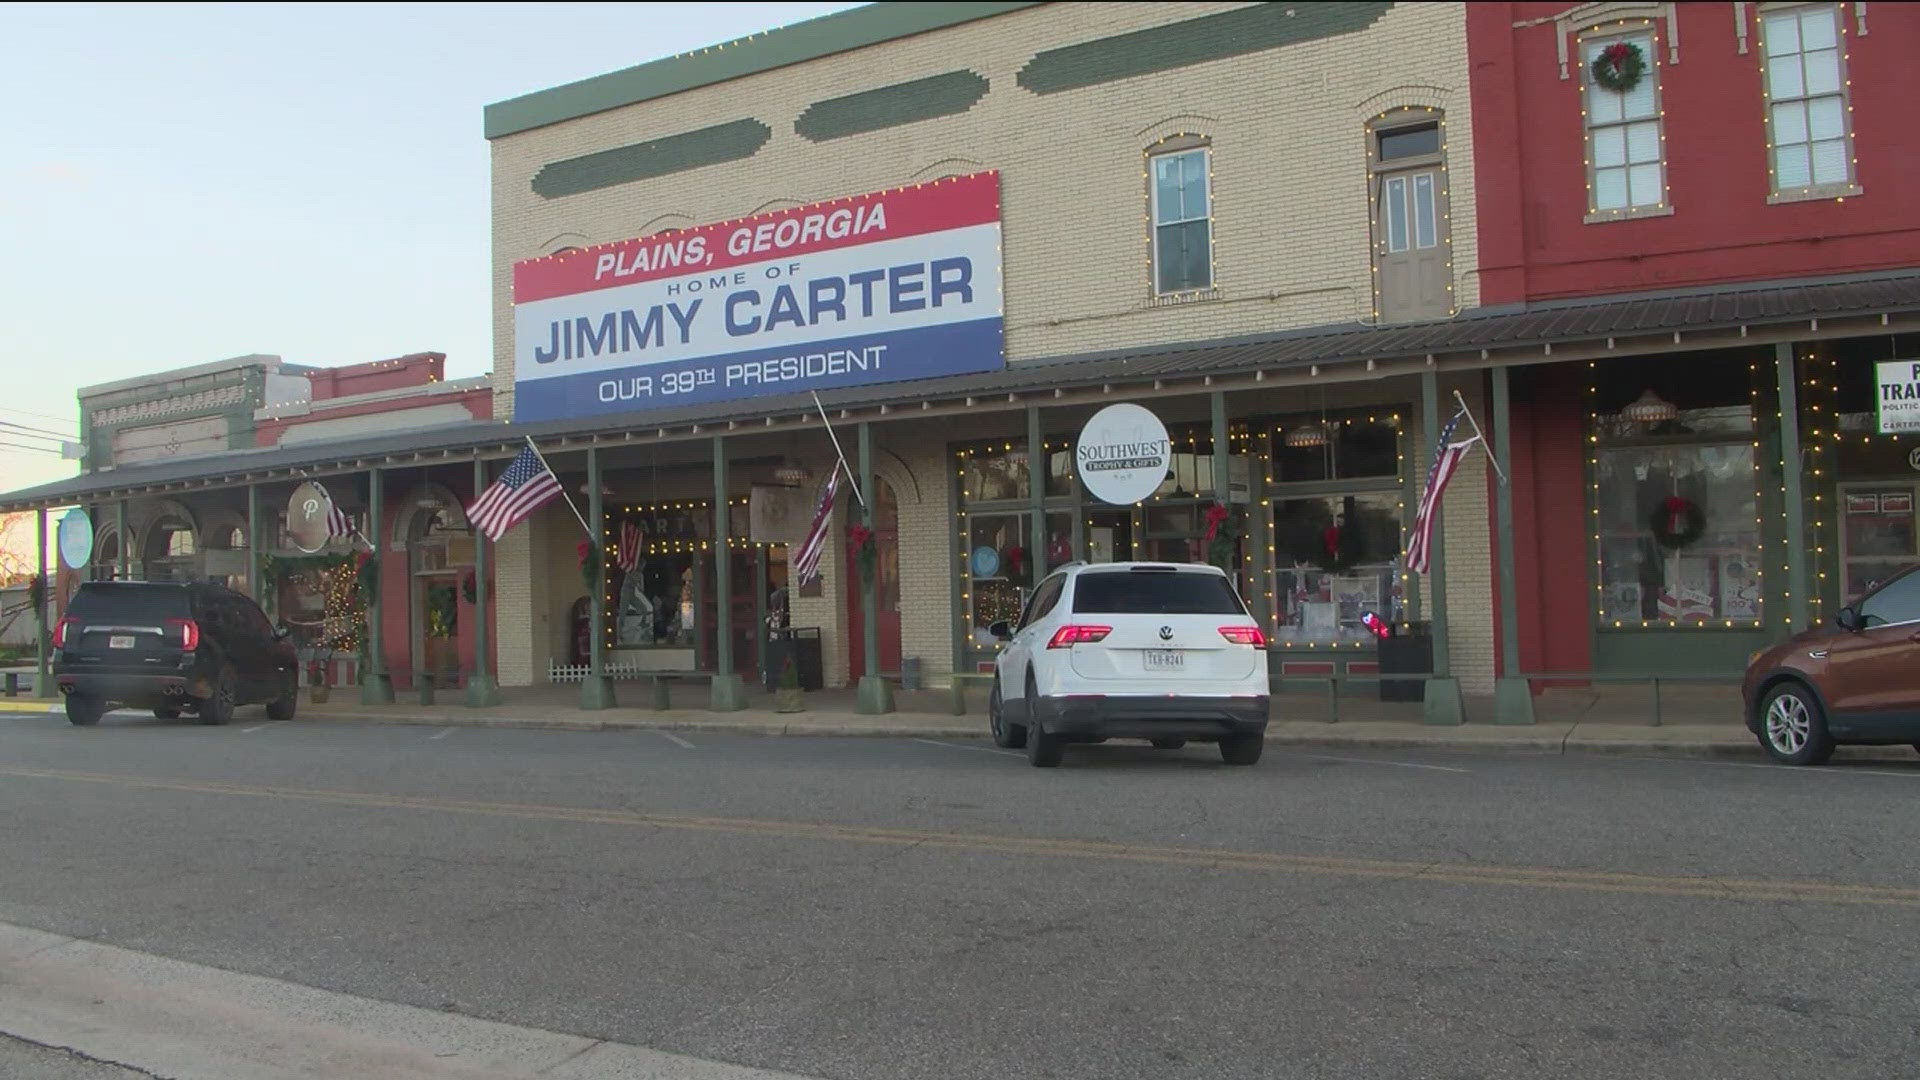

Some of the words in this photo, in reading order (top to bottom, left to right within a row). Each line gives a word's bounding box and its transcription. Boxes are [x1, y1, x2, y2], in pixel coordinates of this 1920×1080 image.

[594, 236, 714, 281] PLAINS,
[727, 202, 887, 257] GEORGIA
[667, 272, 746, 296] HOME
[765, 262, 801, 279] OF
[534, 298, 703, 365] JIMMY
[724, 256, 974, 337] CARTER
[598, 377, 653, 402] OUR
[660, 367, 716, 395] 39TH
[726, 345, 887, 387] PRESIDENT
[1078, 439, 1168, 461] SOUTHWEST
[1088, 460, 1123, 471] TROPHY
[1124, 460, 1133, 469] &
[1133, 457, 1161, 468] GIFTS
